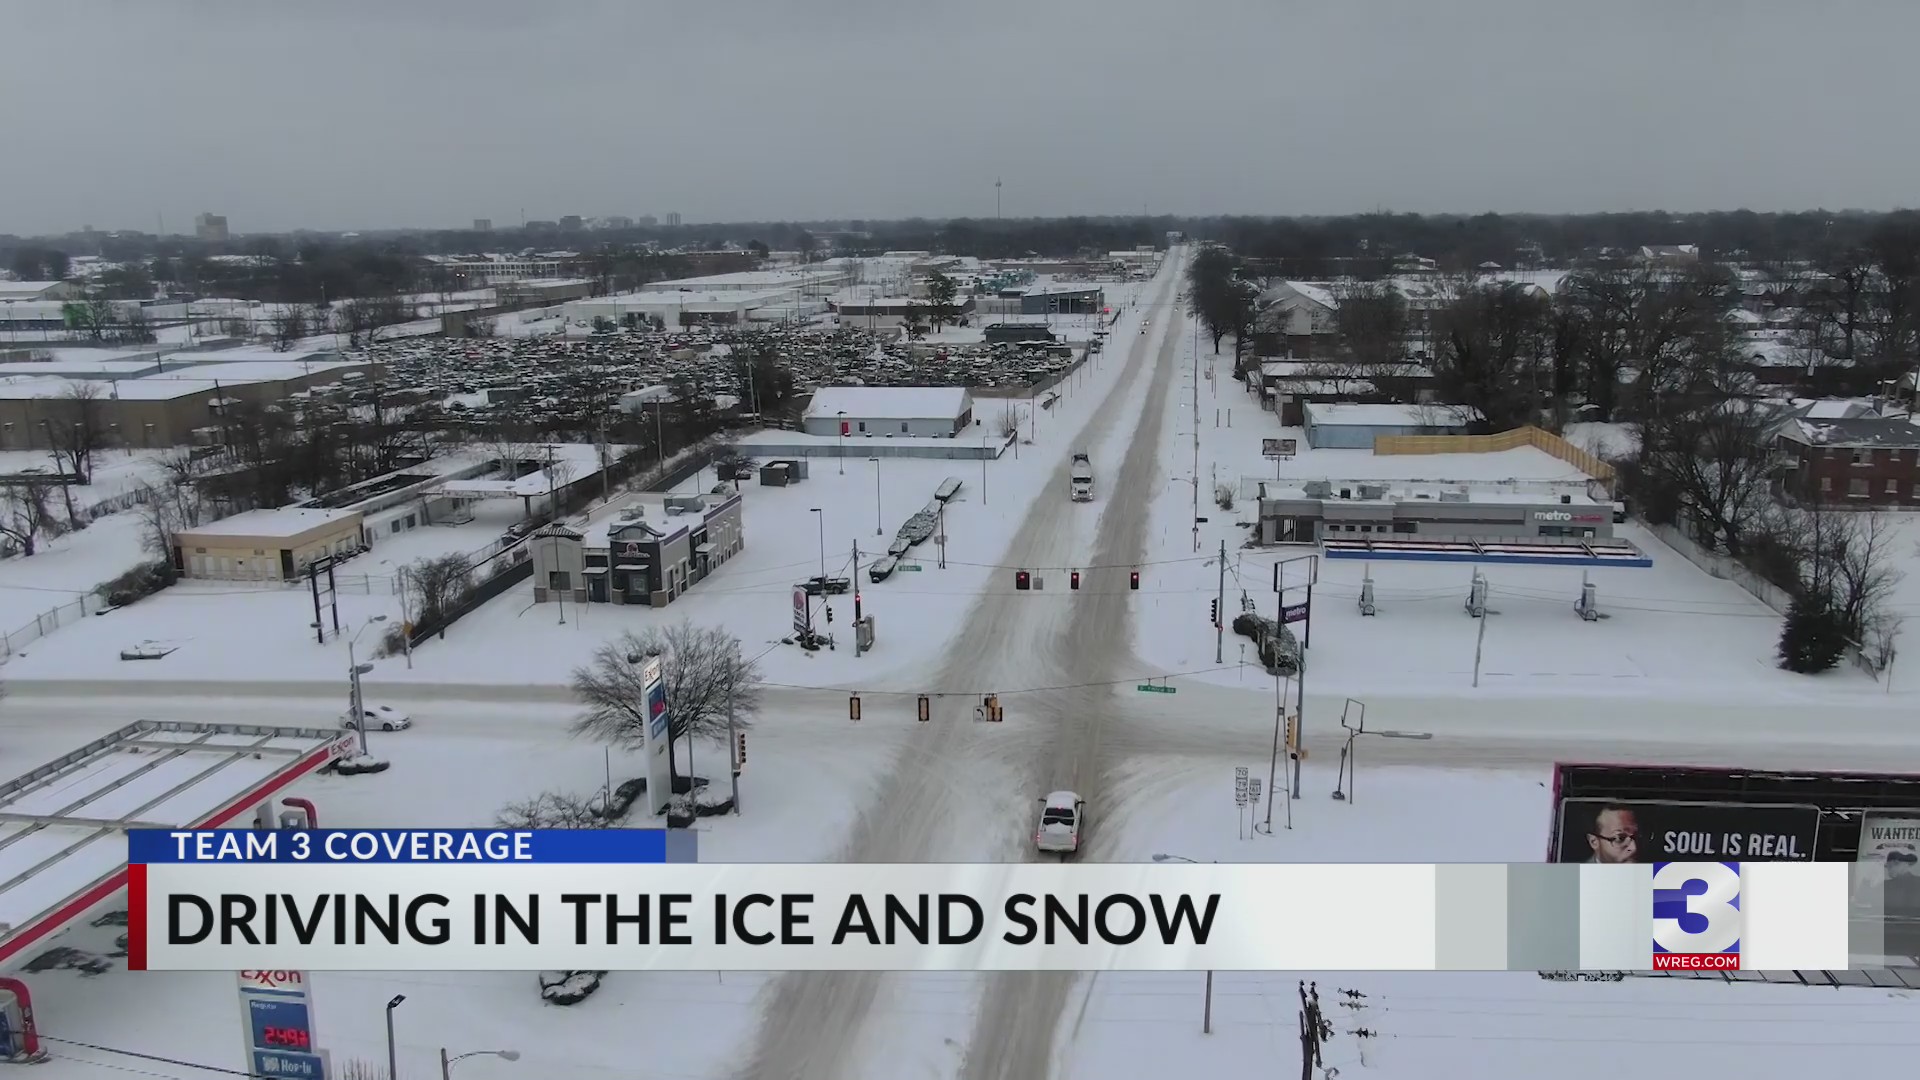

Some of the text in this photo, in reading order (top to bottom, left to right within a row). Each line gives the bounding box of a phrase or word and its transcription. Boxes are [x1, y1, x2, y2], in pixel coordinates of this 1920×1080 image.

[1534, 510, 1572, 521] metro
[1285, 606, 1307, 617] metro
[1237, 769, 1247, 777] 70
[1664, 830, 1807, 859] SOUL IS REAL.
